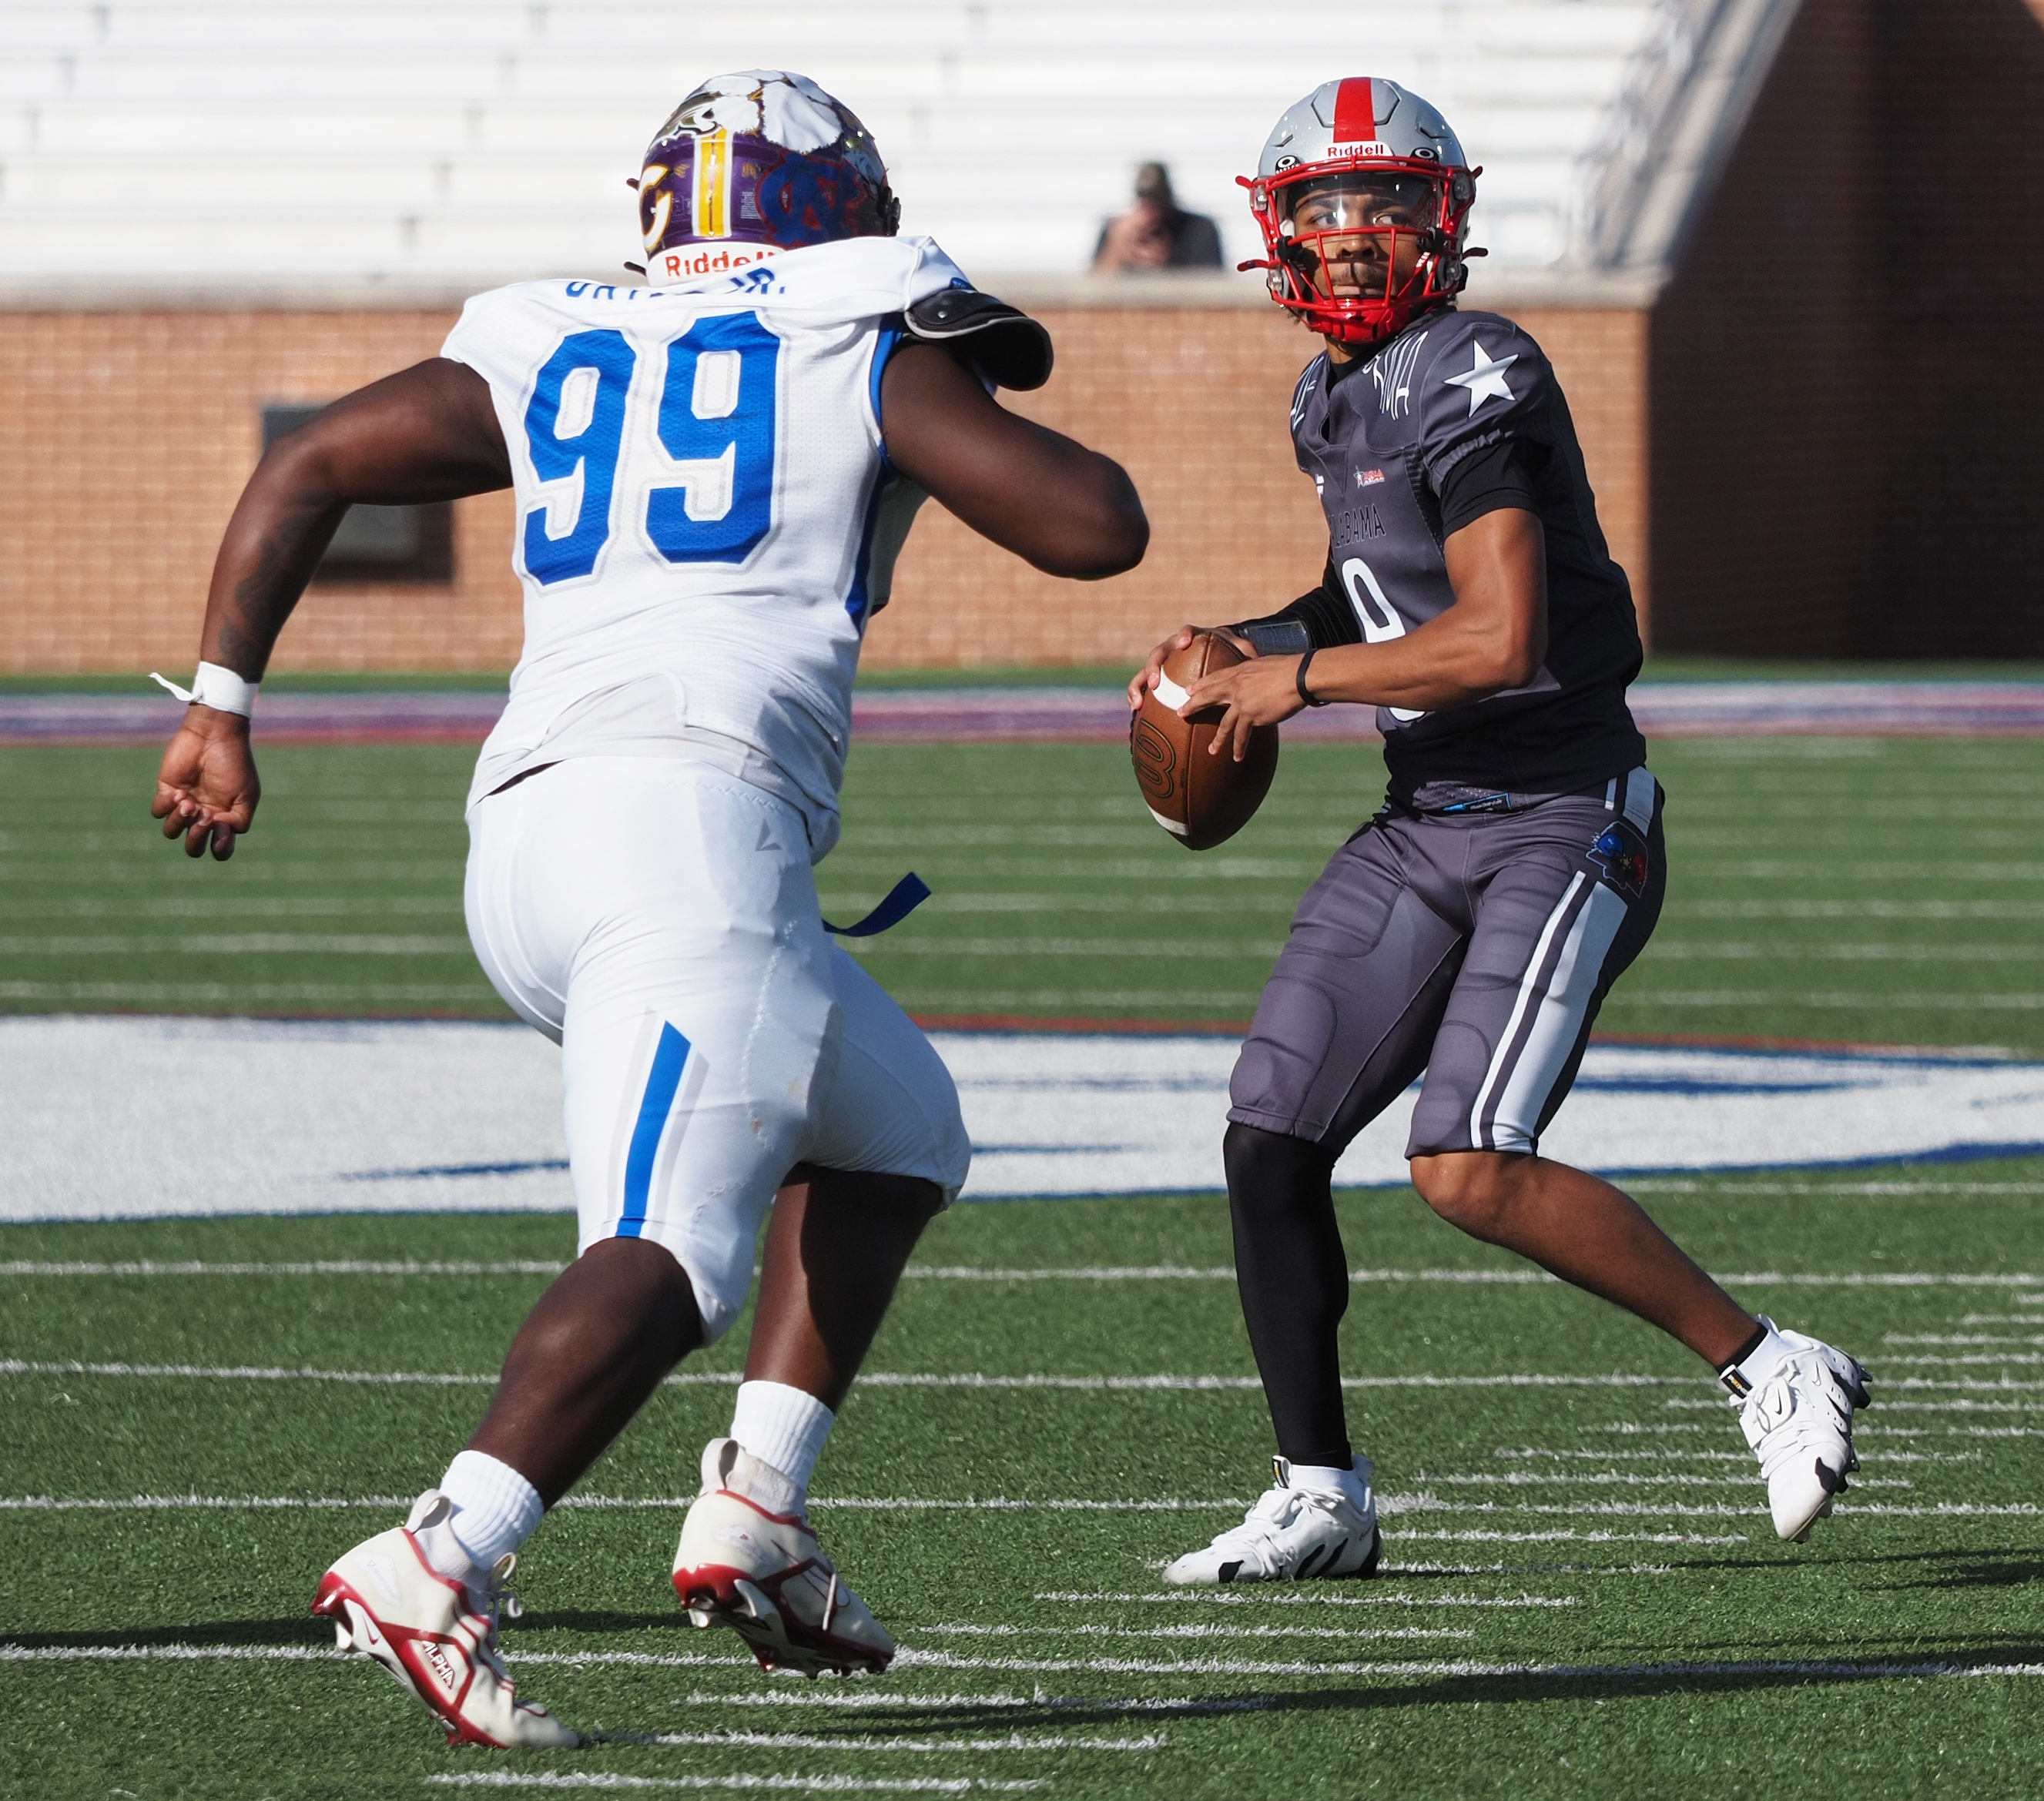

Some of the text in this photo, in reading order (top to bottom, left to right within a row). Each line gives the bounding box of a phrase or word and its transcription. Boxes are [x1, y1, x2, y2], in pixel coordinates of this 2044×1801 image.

[1327, 144, 1384, 157] Riddell
[524, 310, 781, 587] 99
[421, 1640, 453, 1690] ALPHA
